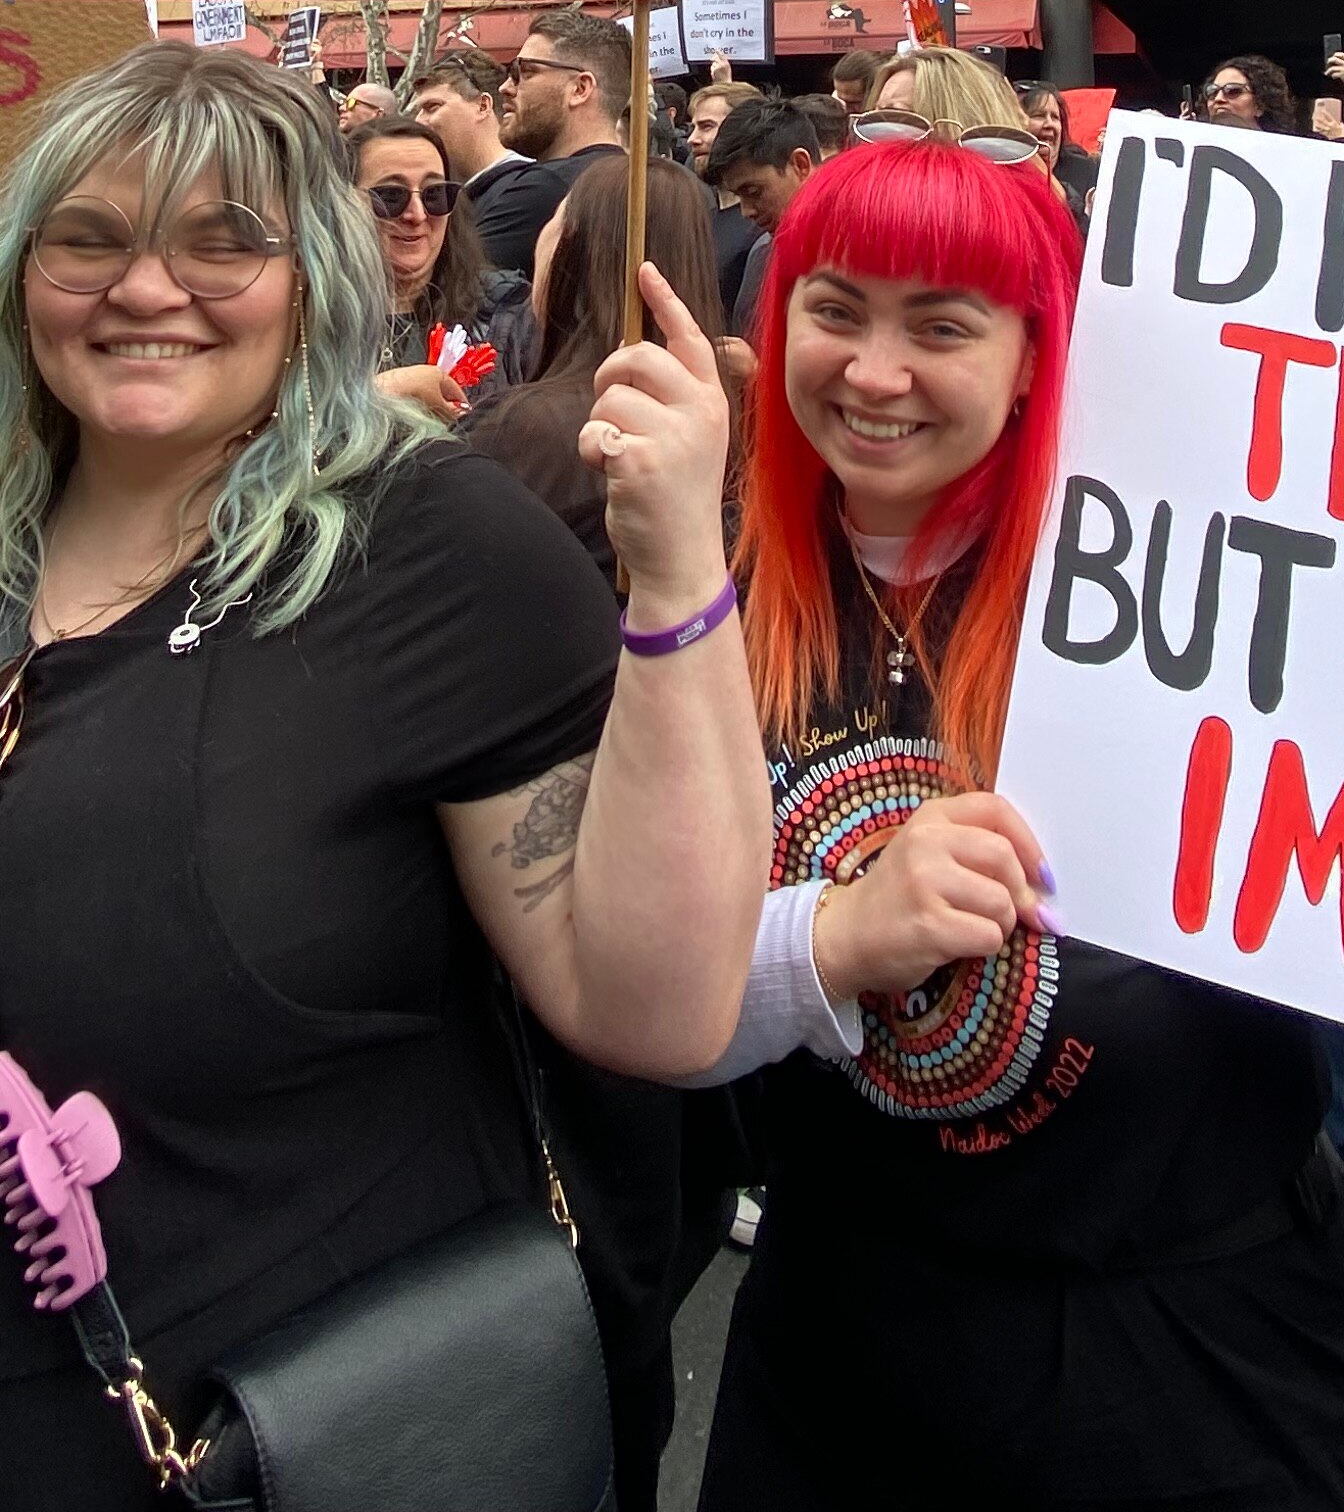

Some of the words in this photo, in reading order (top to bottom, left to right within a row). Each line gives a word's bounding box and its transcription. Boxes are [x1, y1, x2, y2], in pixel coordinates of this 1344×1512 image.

[694, 10, 741, 22] Sometimes
[743, 9, 747, 20] I
[690, 28, 709, 38] don't
[710, 30, 723, 40] cry
[725, 28, 735, 37] in
[737, 28, 754, 37] the
[659, 47, 675, 56] the
[1101, 131, 1280, 304] I'D
[1042, 473, 1337, 715] BUT
[800, 727, 848, 757] Show
[1045, 1037, 1095, 1099] 2022
